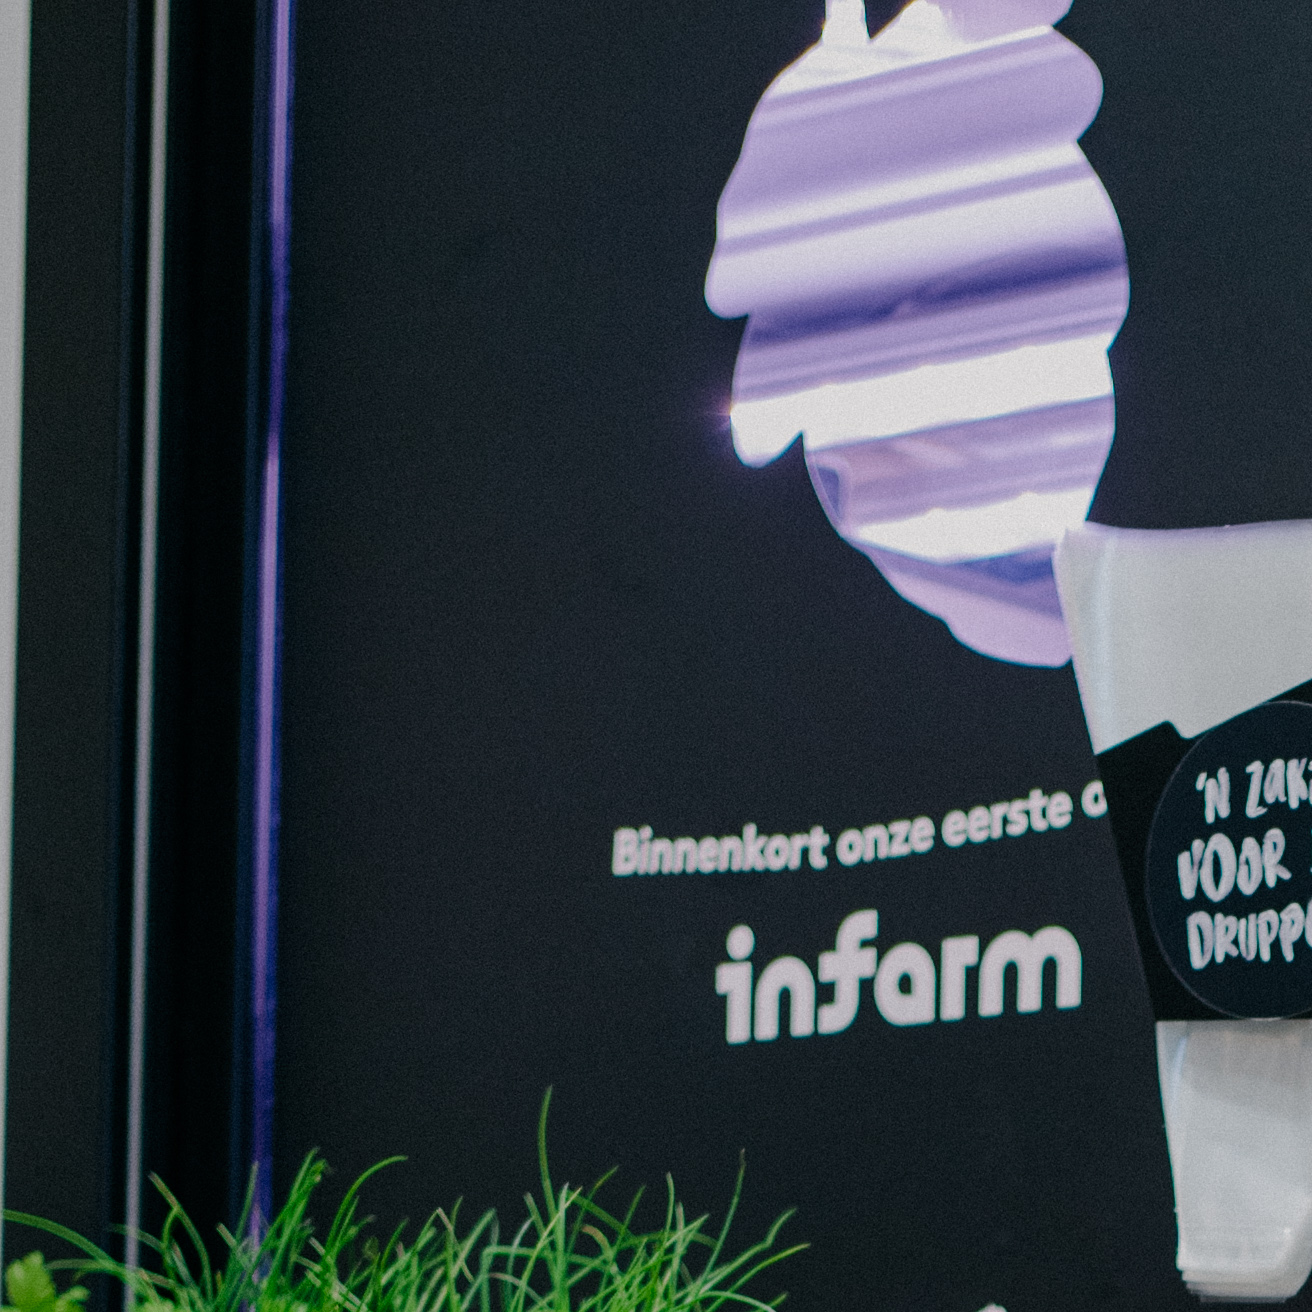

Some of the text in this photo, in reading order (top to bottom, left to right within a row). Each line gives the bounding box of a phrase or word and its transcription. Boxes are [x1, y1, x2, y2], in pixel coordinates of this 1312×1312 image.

[611, 823, 830, 877] Binnenkort
[836, 811, 936, 864] onze
[941, 787, 1074, 849] eerste
[1177, 832, 1292, 903] VOOR
[715, 908, 1083, 1045] infarm
